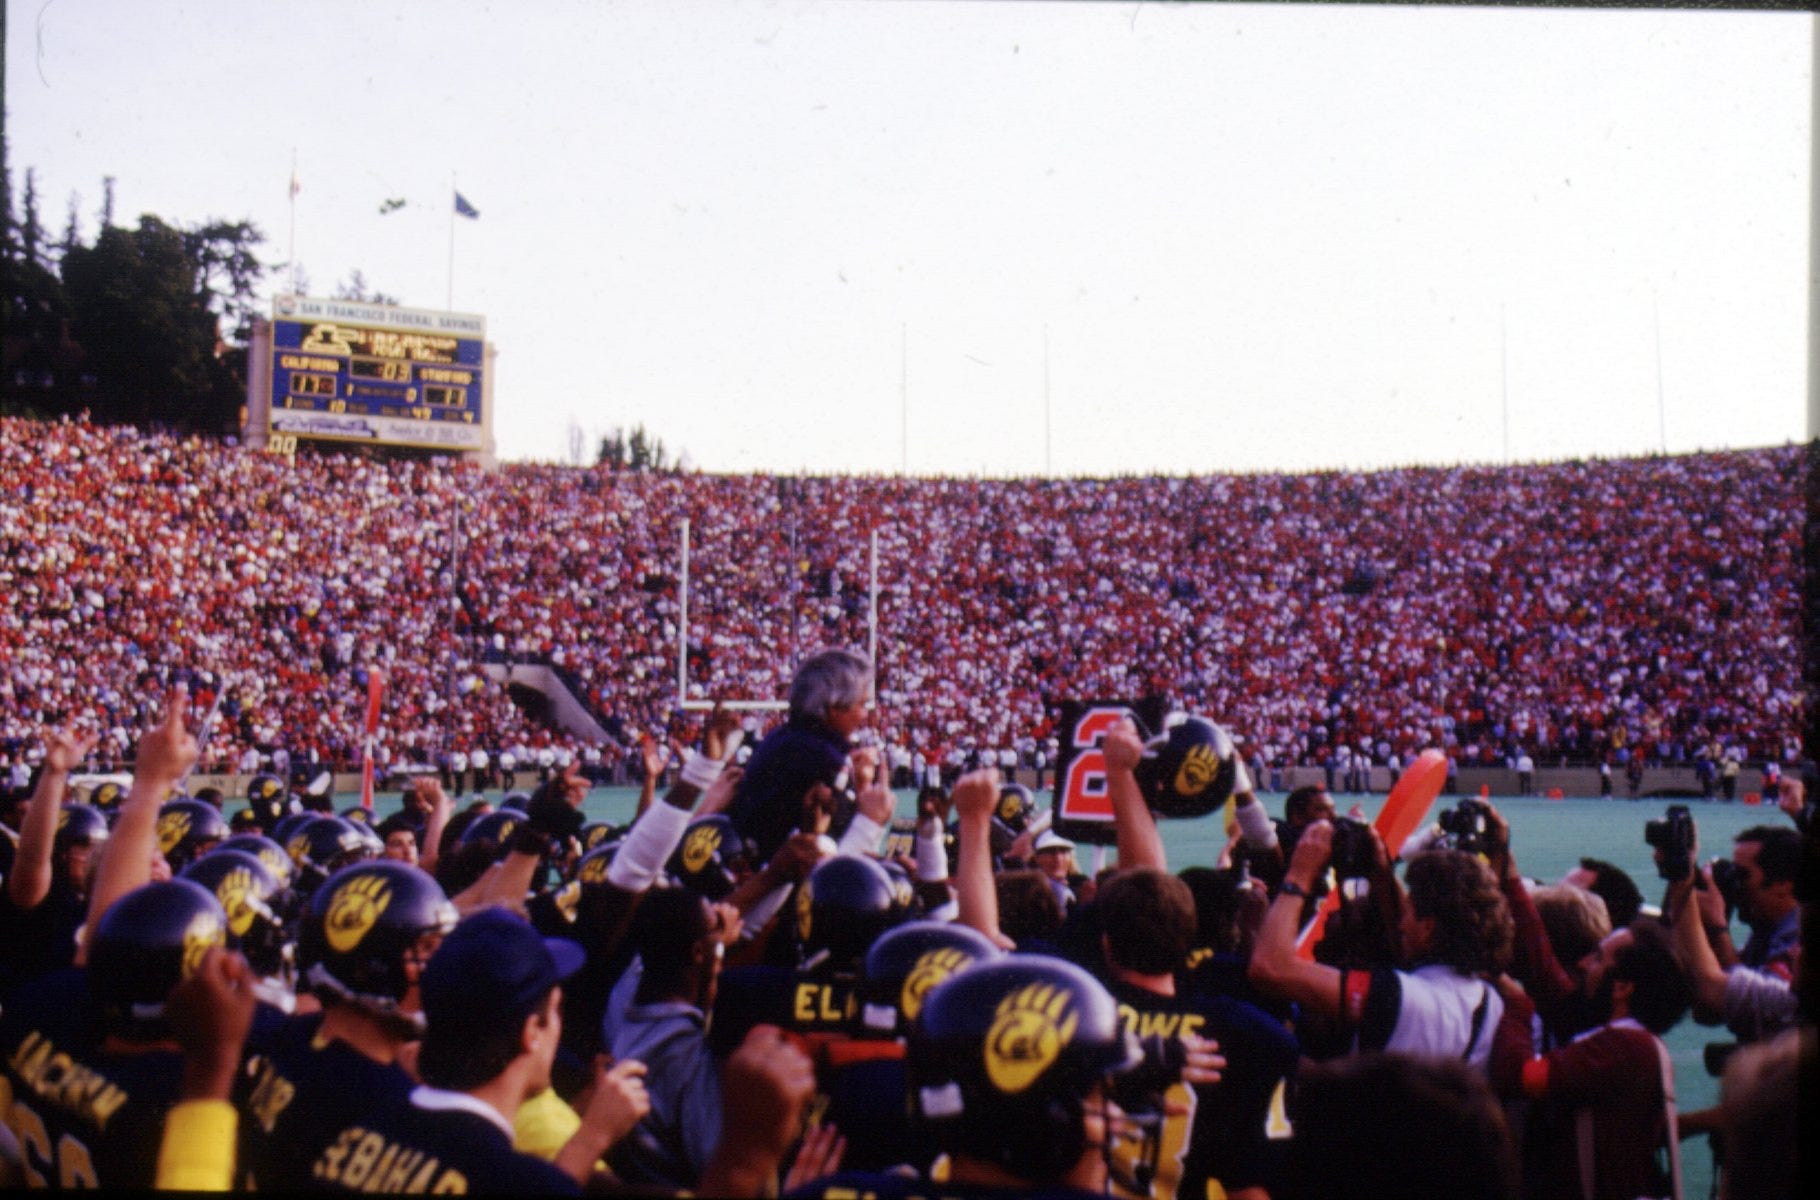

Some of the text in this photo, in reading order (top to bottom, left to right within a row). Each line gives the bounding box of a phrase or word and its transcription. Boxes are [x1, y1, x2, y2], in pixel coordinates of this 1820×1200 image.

[302, 302, 481, 331] SAN FRANCISCO FEDERAL SAVINGS
